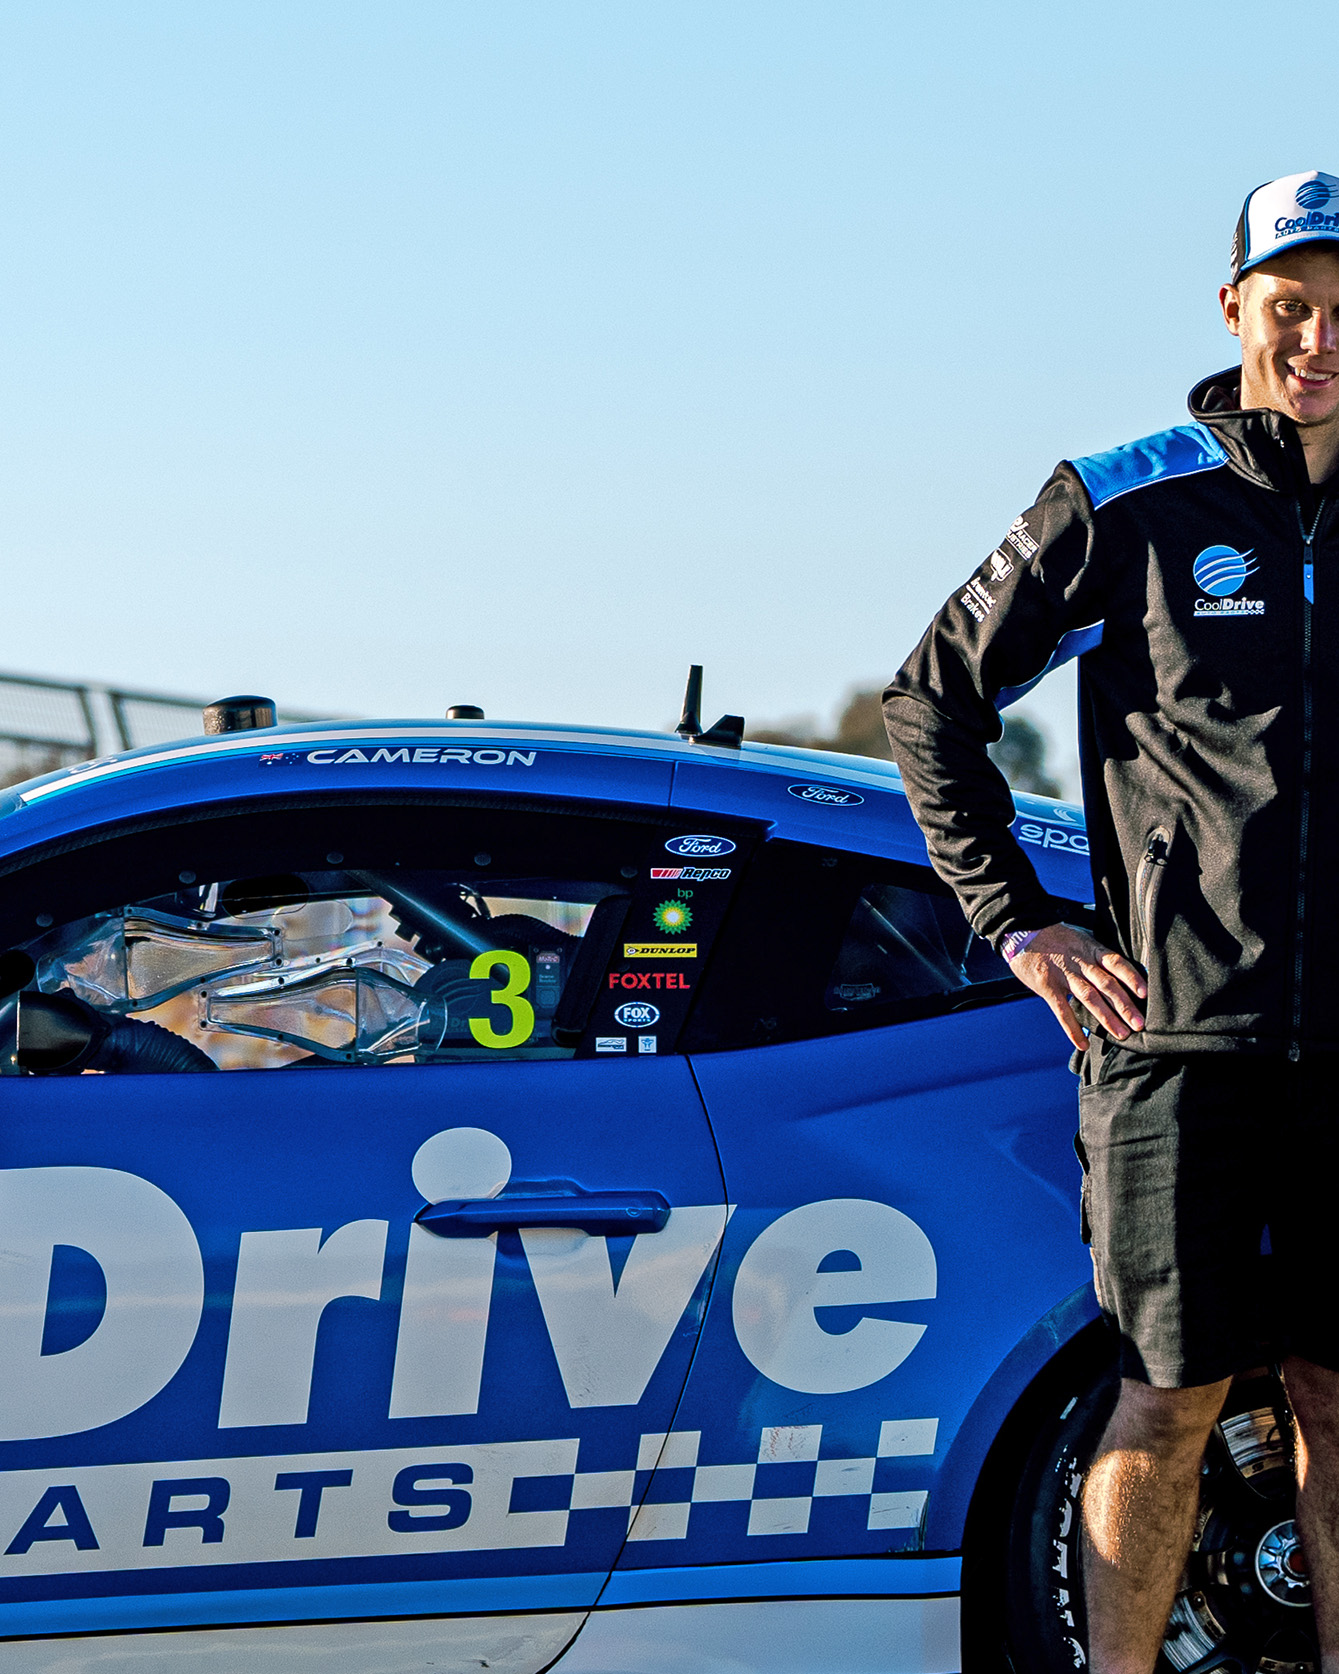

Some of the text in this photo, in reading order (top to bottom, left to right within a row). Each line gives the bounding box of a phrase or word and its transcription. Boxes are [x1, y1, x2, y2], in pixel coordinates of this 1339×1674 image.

[1194, 597, 1265, 610] CoolDrive
[306, 748, 537, 767] CAMERON
[801, 786, 849, 805] Ford
[678, 837, 722, 854] Ford
[679, 866, 732, 881] Repco
[677, 887, 694, 899] bp
[638, 946, 697, 955] DUNLOP
[608, 972, 691, 990] FOXTEL
[468, 949, 535, 1049] 3
[623, 1007, 651, 1019] FOX
